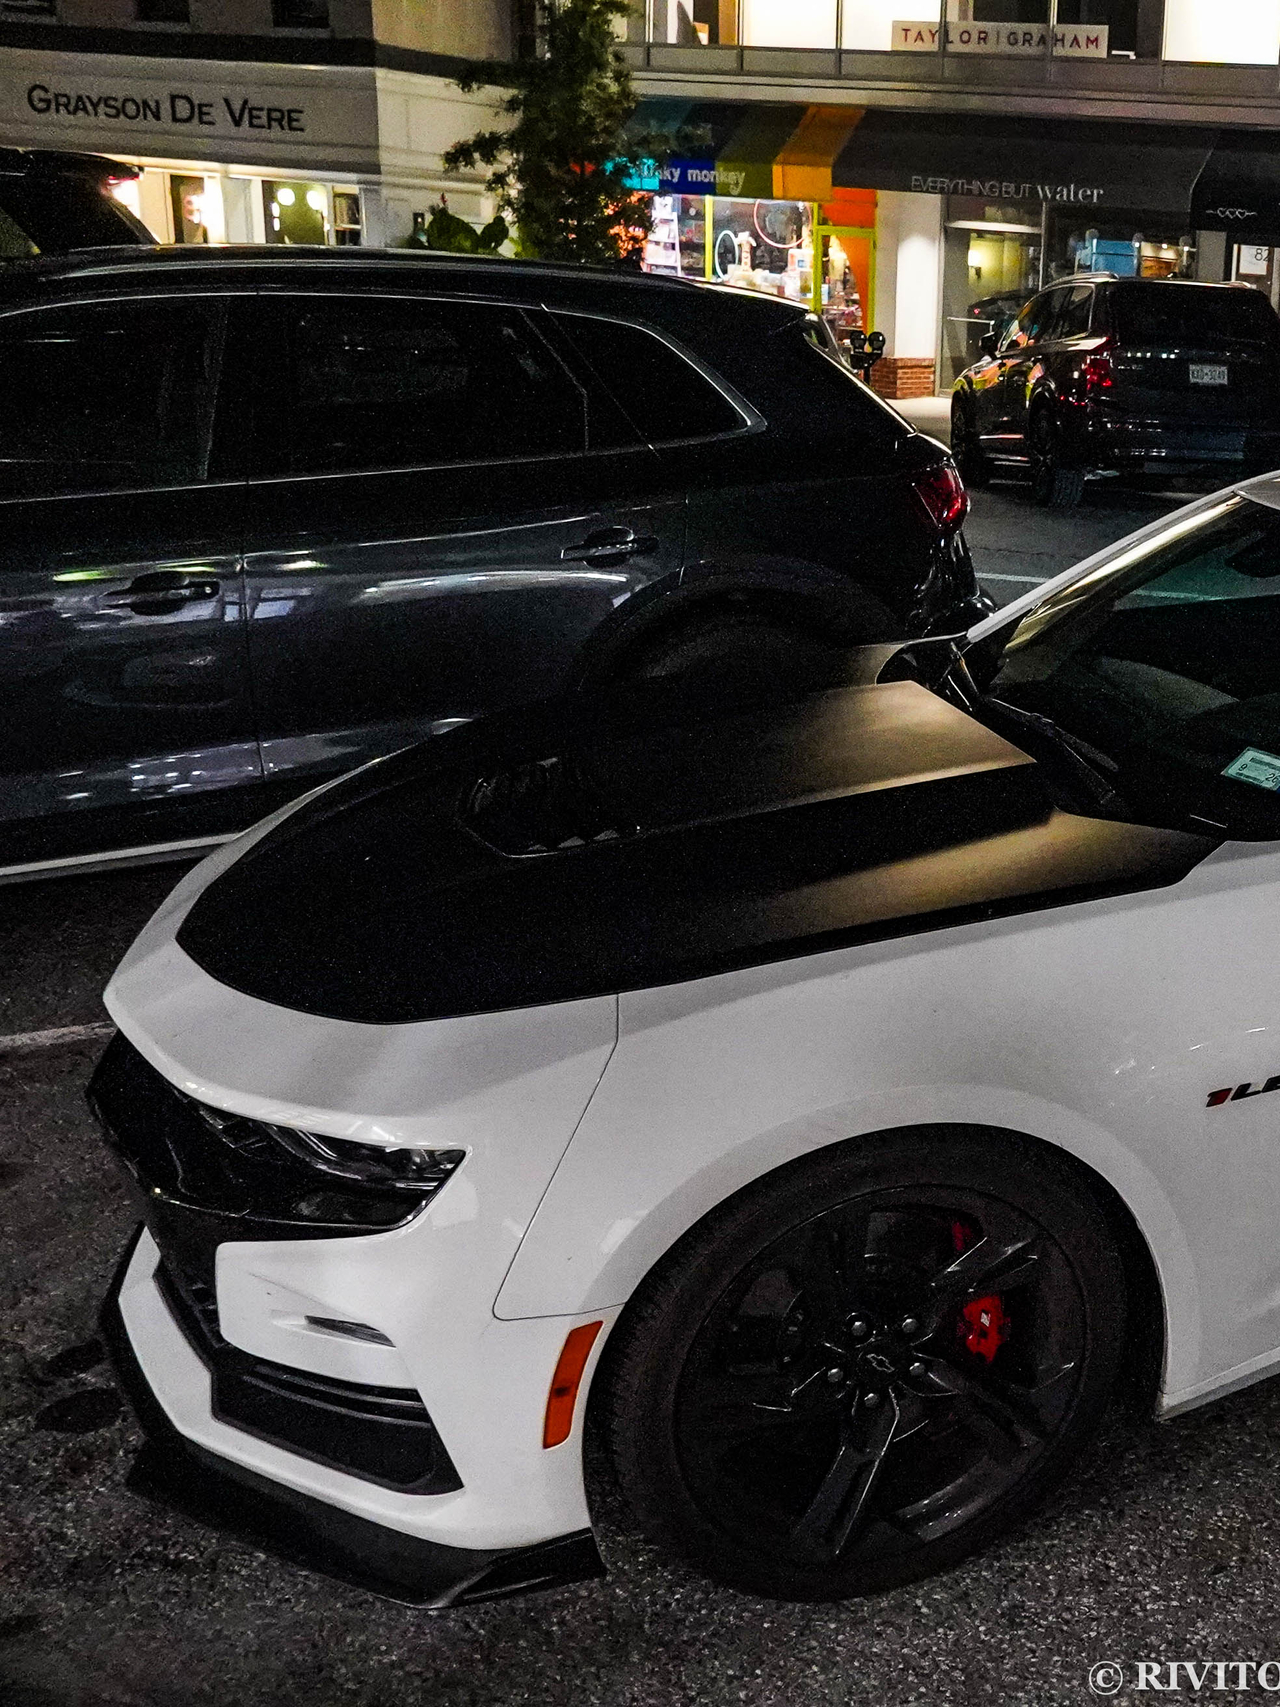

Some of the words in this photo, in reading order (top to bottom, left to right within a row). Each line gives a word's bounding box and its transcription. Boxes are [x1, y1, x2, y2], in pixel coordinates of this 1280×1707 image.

[901, 28, 988, 46] TAYLOR
[1006, 31, 1100, 50] GRAHAM
[687, 167, 746, 195] monkey
[911, 175, 1000, 197] EVERYTHING
[1001, 182, 1033, 199] BUT
[1036, 183, 1104, 203] water
